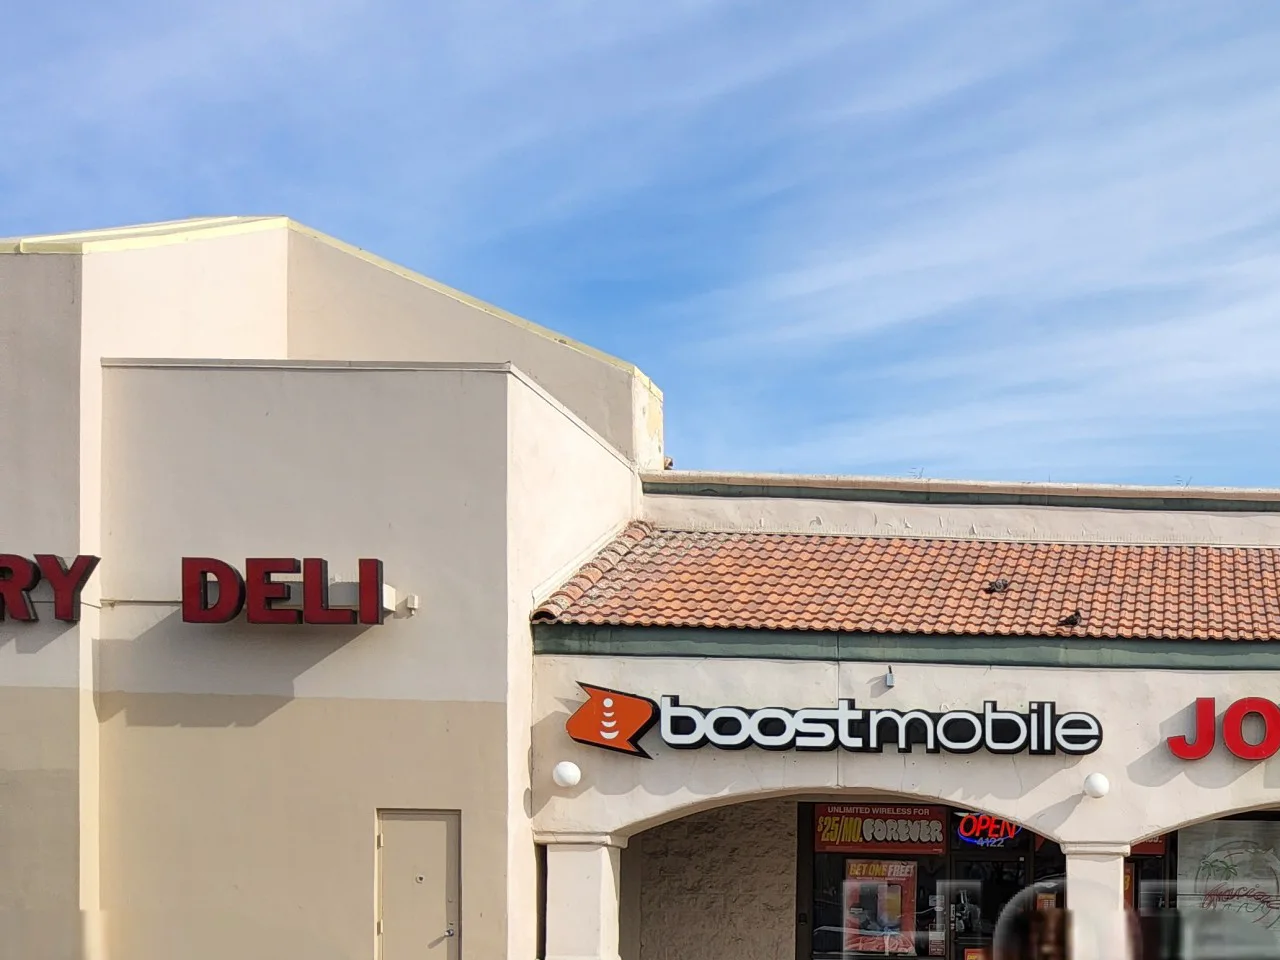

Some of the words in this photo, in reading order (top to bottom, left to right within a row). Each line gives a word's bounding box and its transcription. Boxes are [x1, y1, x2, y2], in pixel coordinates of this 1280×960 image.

[182, 557, 384, 625] DELI
[827, 805, 870, 814] UNLIMITED
[872, 806, 911, 815] WIRELESS
[913, 807, 930, 816] FOR
[817, 815, 863, 845] $25/MO.
[862, 818, 943, 842] FOREVER
[960, 814, 1017, 838] OPEN
[976, 837, 1005, 848] 4122
